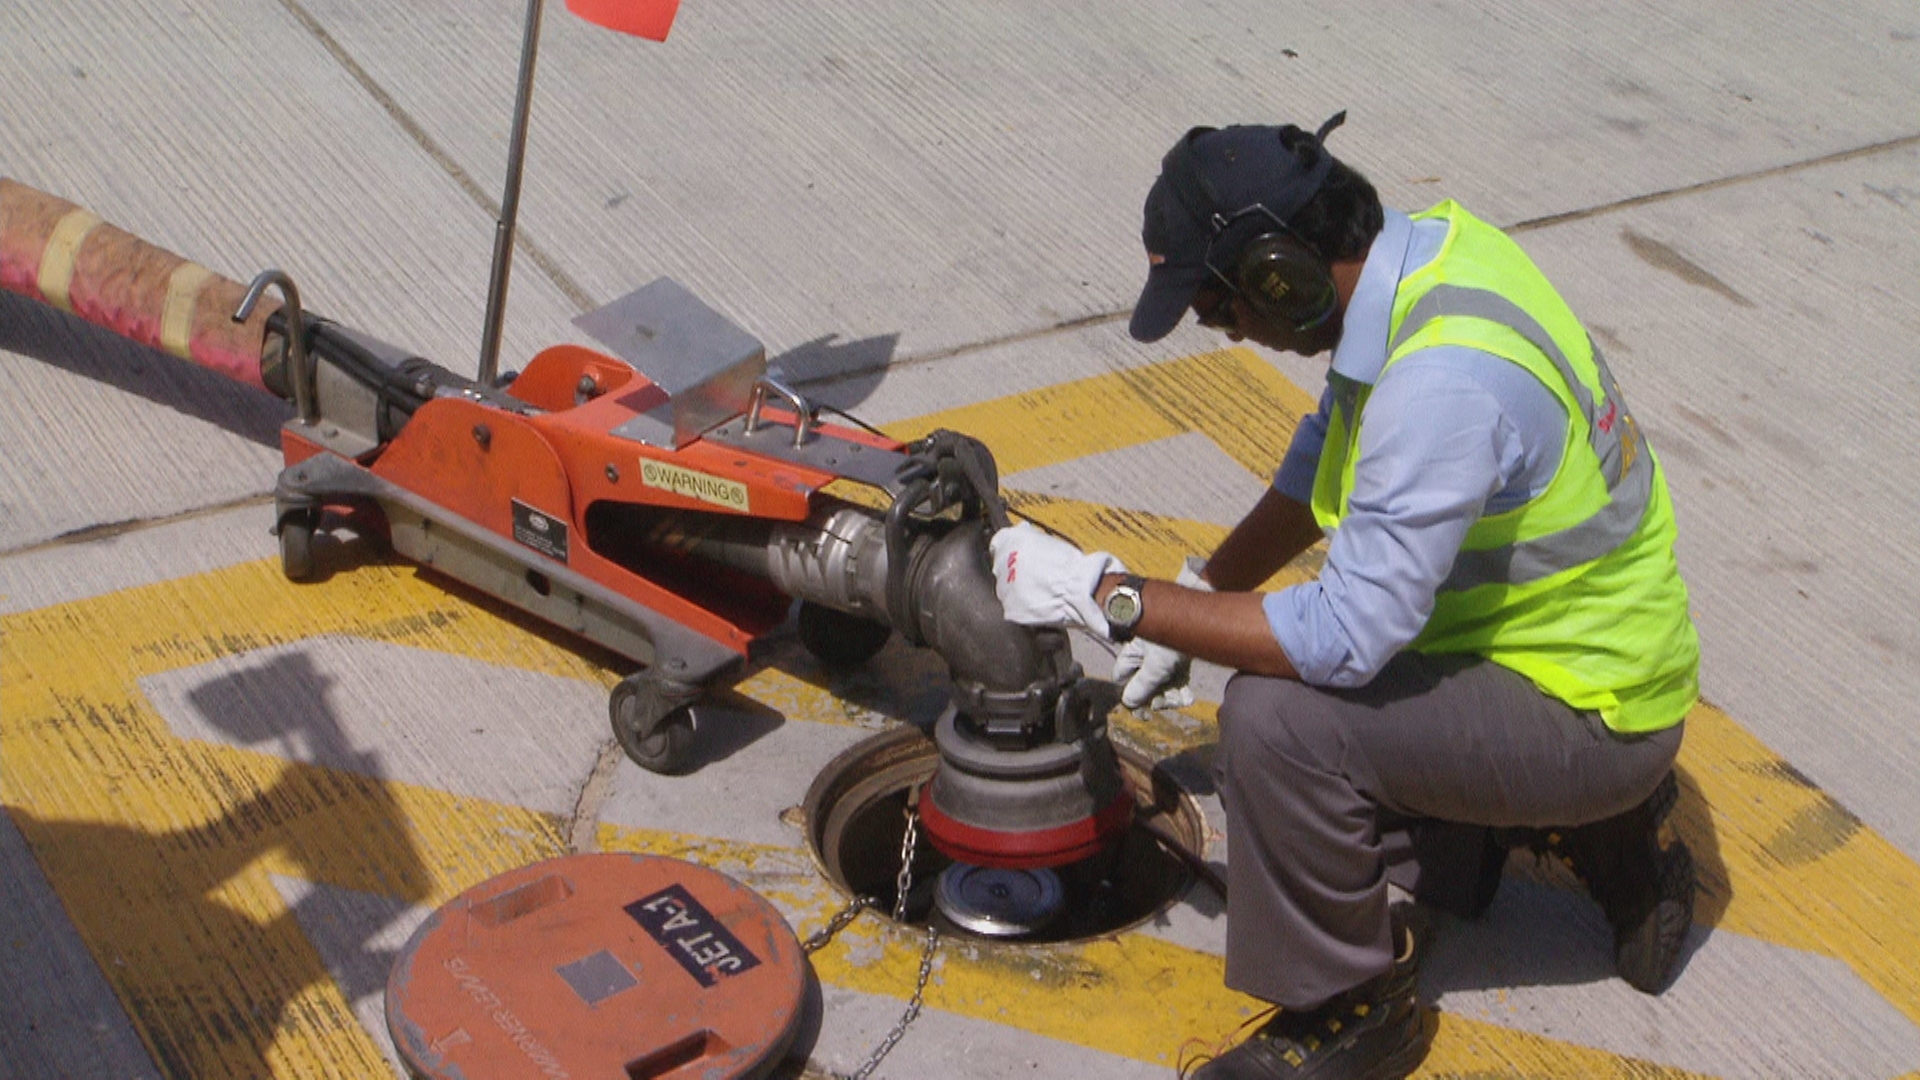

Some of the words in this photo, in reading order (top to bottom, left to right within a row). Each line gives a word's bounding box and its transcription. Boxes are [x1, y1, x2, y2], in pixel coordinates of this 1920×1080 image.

[658, 466, 730, 500] WARNING
[642, 896, 699, 931] A-1
[676, 931, 742, 971] JET
